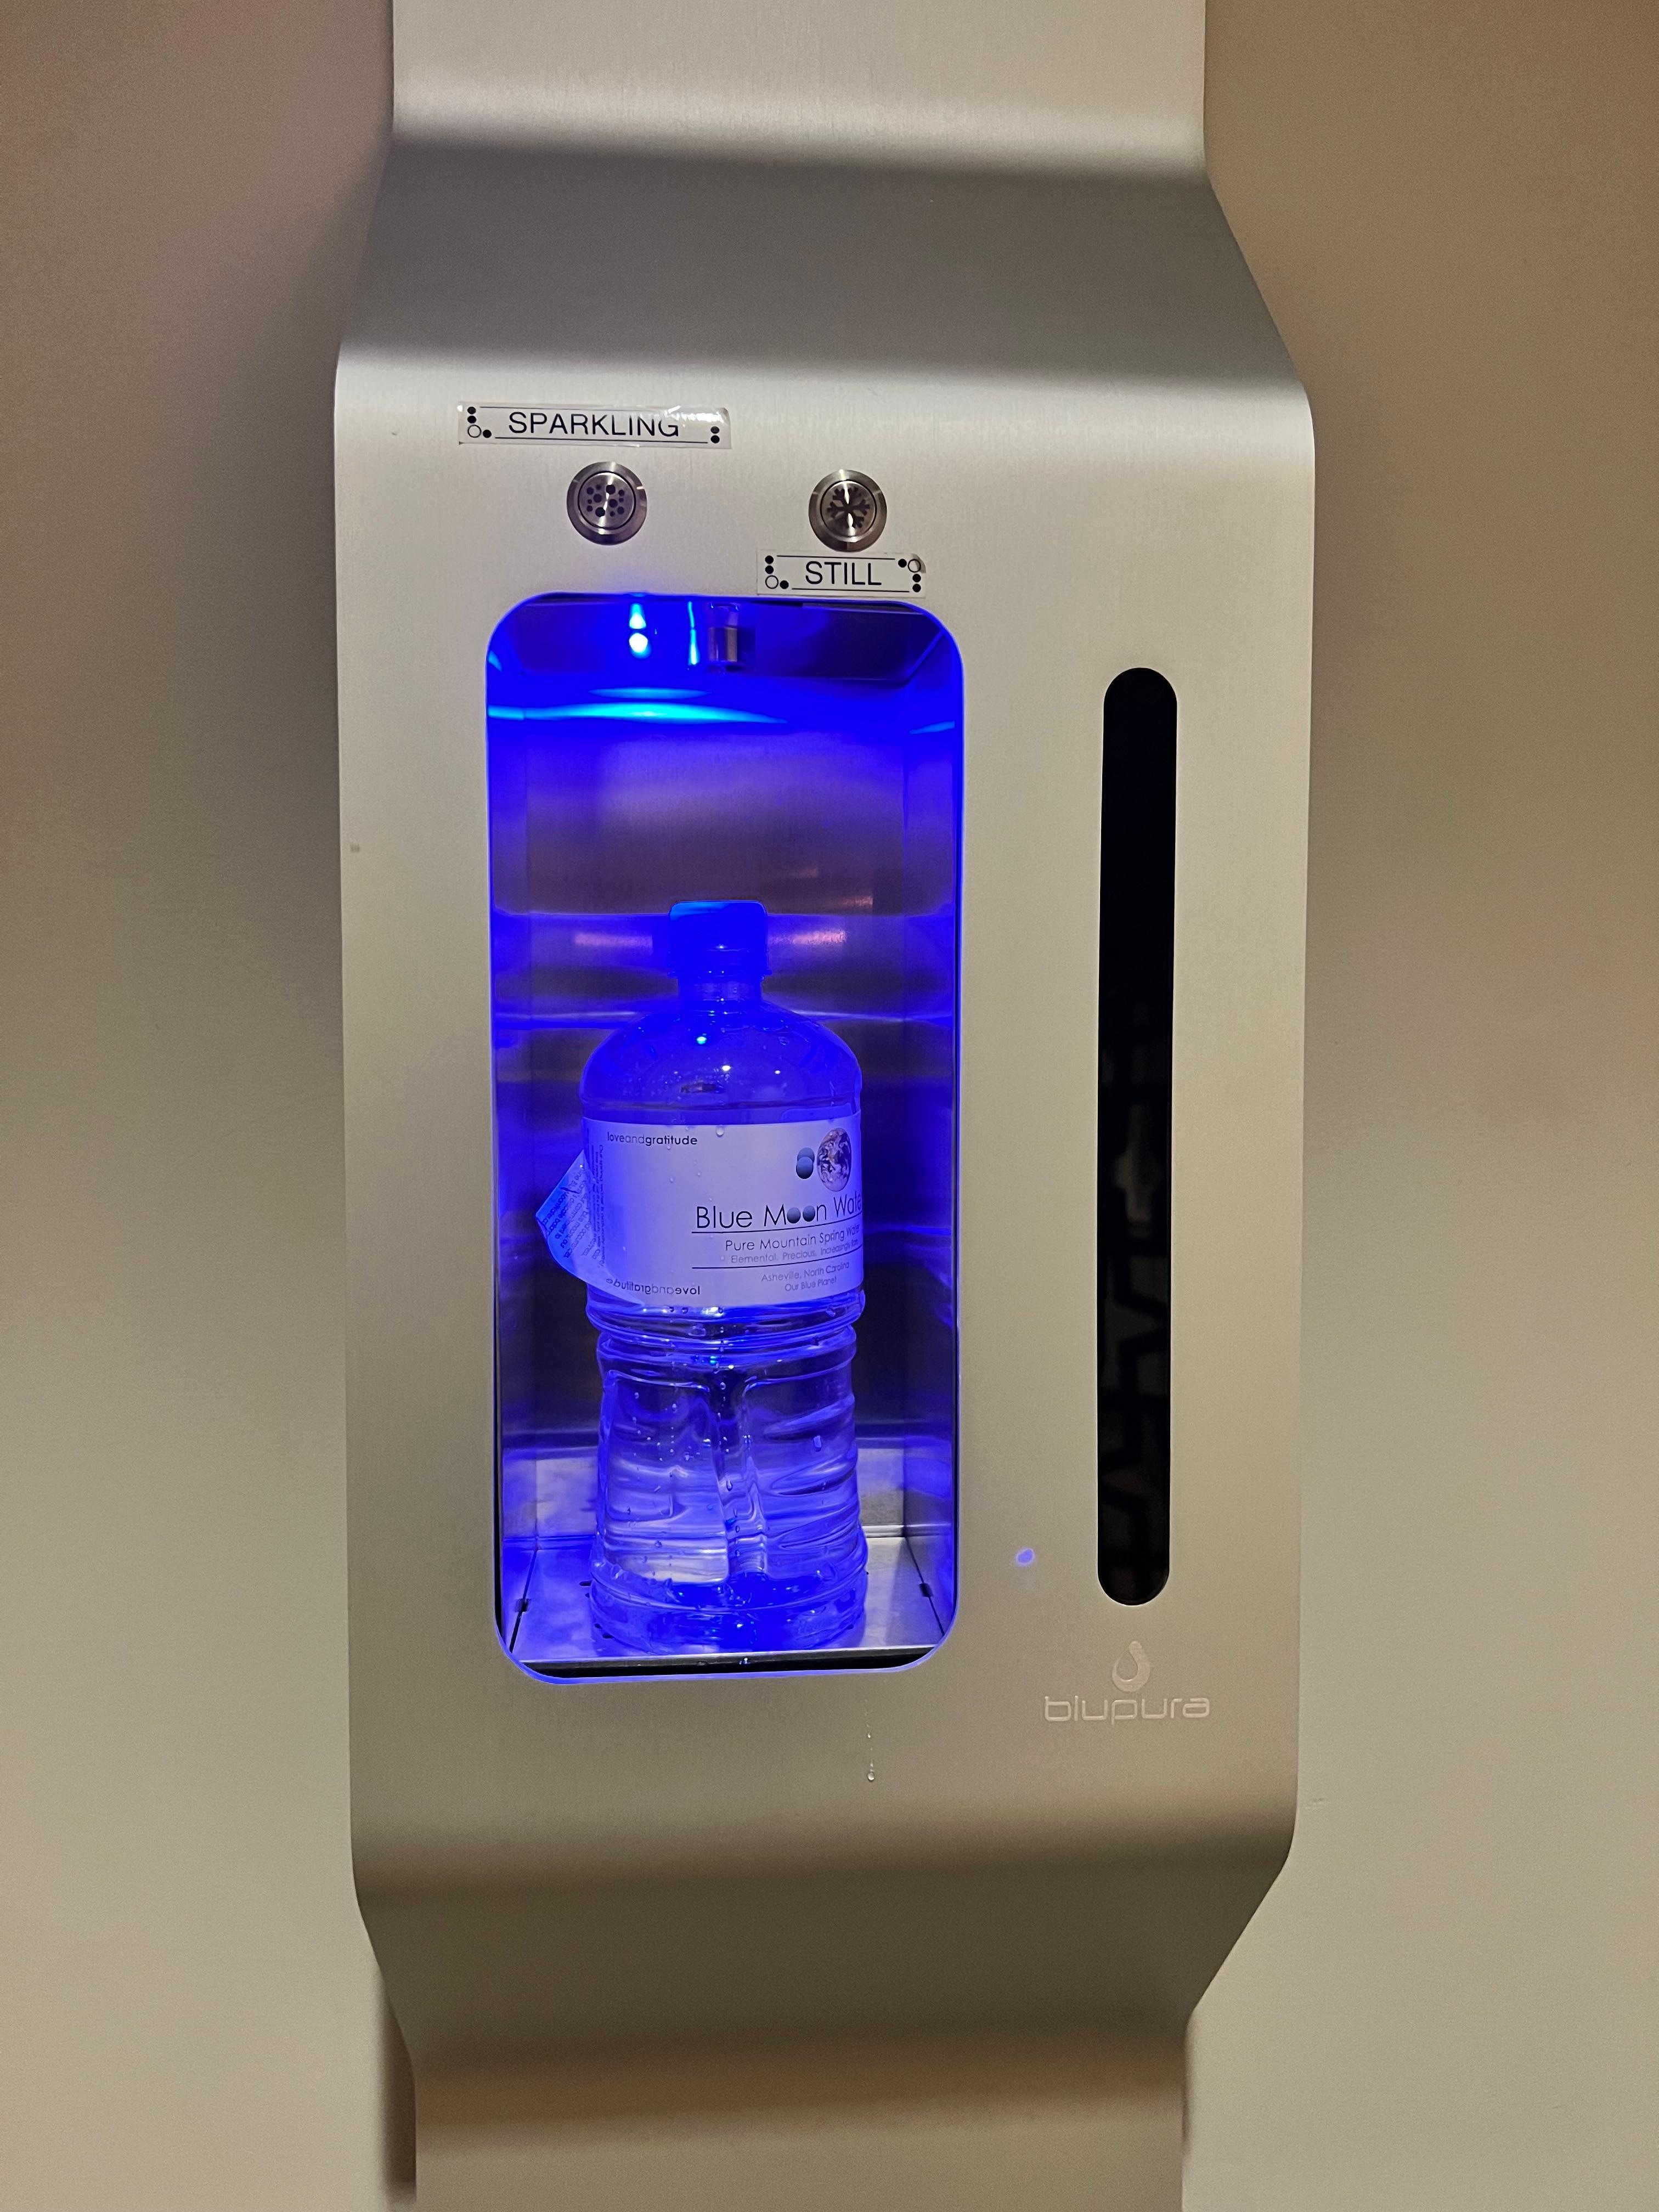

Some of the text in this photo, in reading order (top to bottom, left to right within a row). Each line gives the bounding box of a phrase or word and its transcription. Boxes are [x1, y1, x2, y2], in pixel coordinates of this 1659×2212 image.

[509, 411, 679, 437] SPARKLING
[805, 561, 882, 585] STILL
[607, 1131, 698, 1147] loveandgratitude
[696, 1190, 862, 1229] Blue Moon Wate
[725, 1239, 755, 1251] Pure
[760, 1233, 817, 1250] Mountain
[819, 1229, 845, 1245] Spring
[761, 1261, 850, 1283] Asheville, North Carolina
[785, 1276, 837, 1292] Our Blue Planet
[1043, 1695, 1210, 1725] blupura
